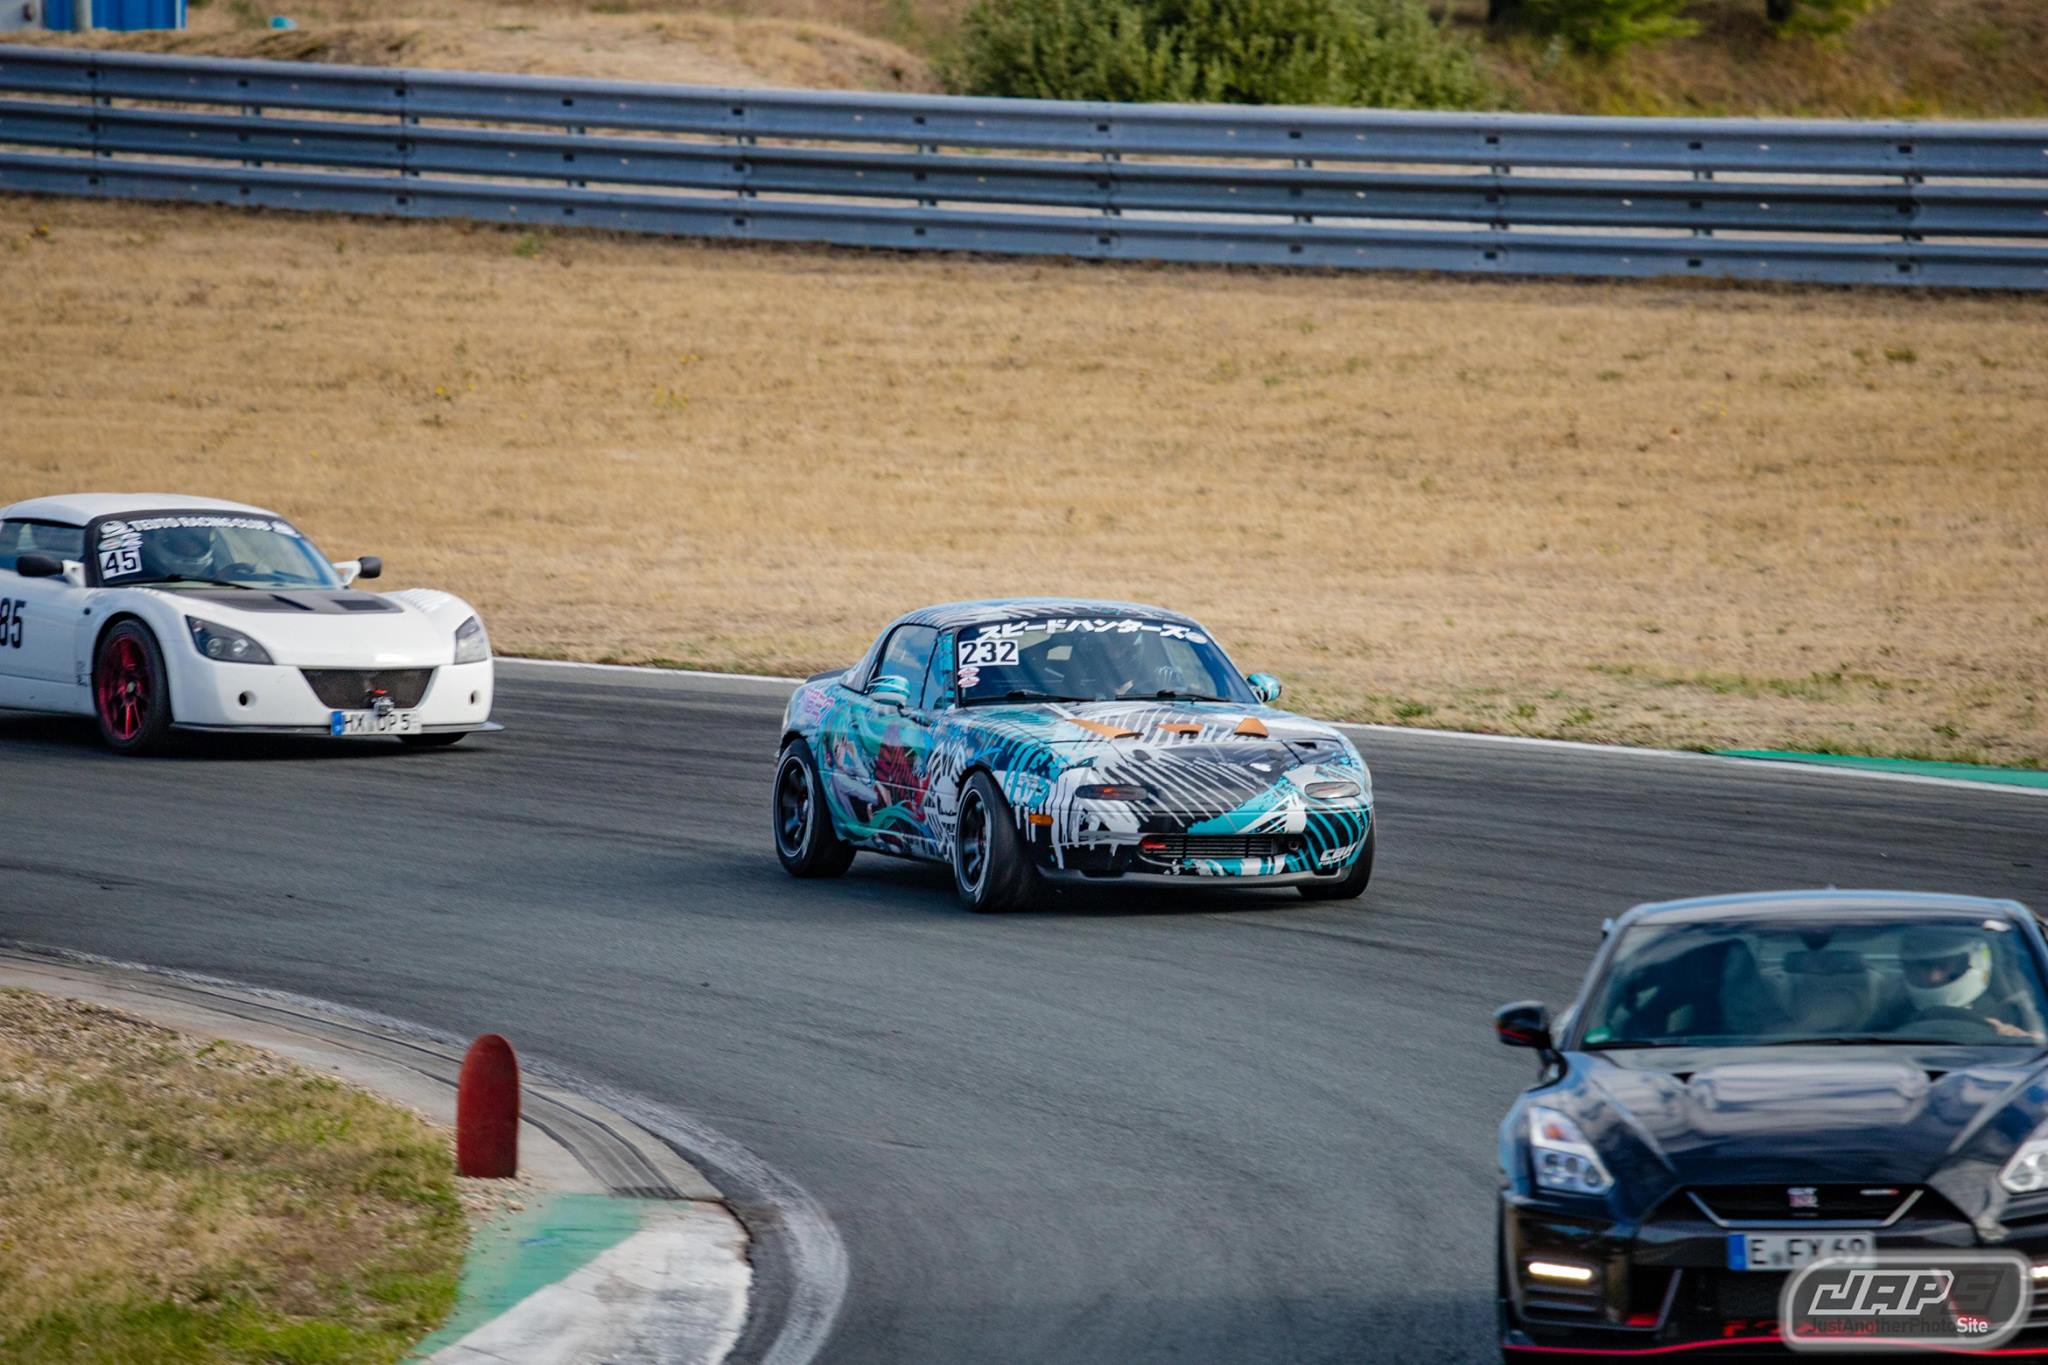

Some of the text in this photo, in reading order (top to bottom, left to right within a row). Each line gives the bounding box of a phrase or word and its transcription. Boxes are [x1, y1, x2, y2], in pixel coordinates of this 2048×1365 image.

[105, 549, 137, 574] 45
[976, 618, 1191, 642] スピードハンターズ
[961, 639, 1018, 666] 232
[1751, 1238, 1768, 1265] E
